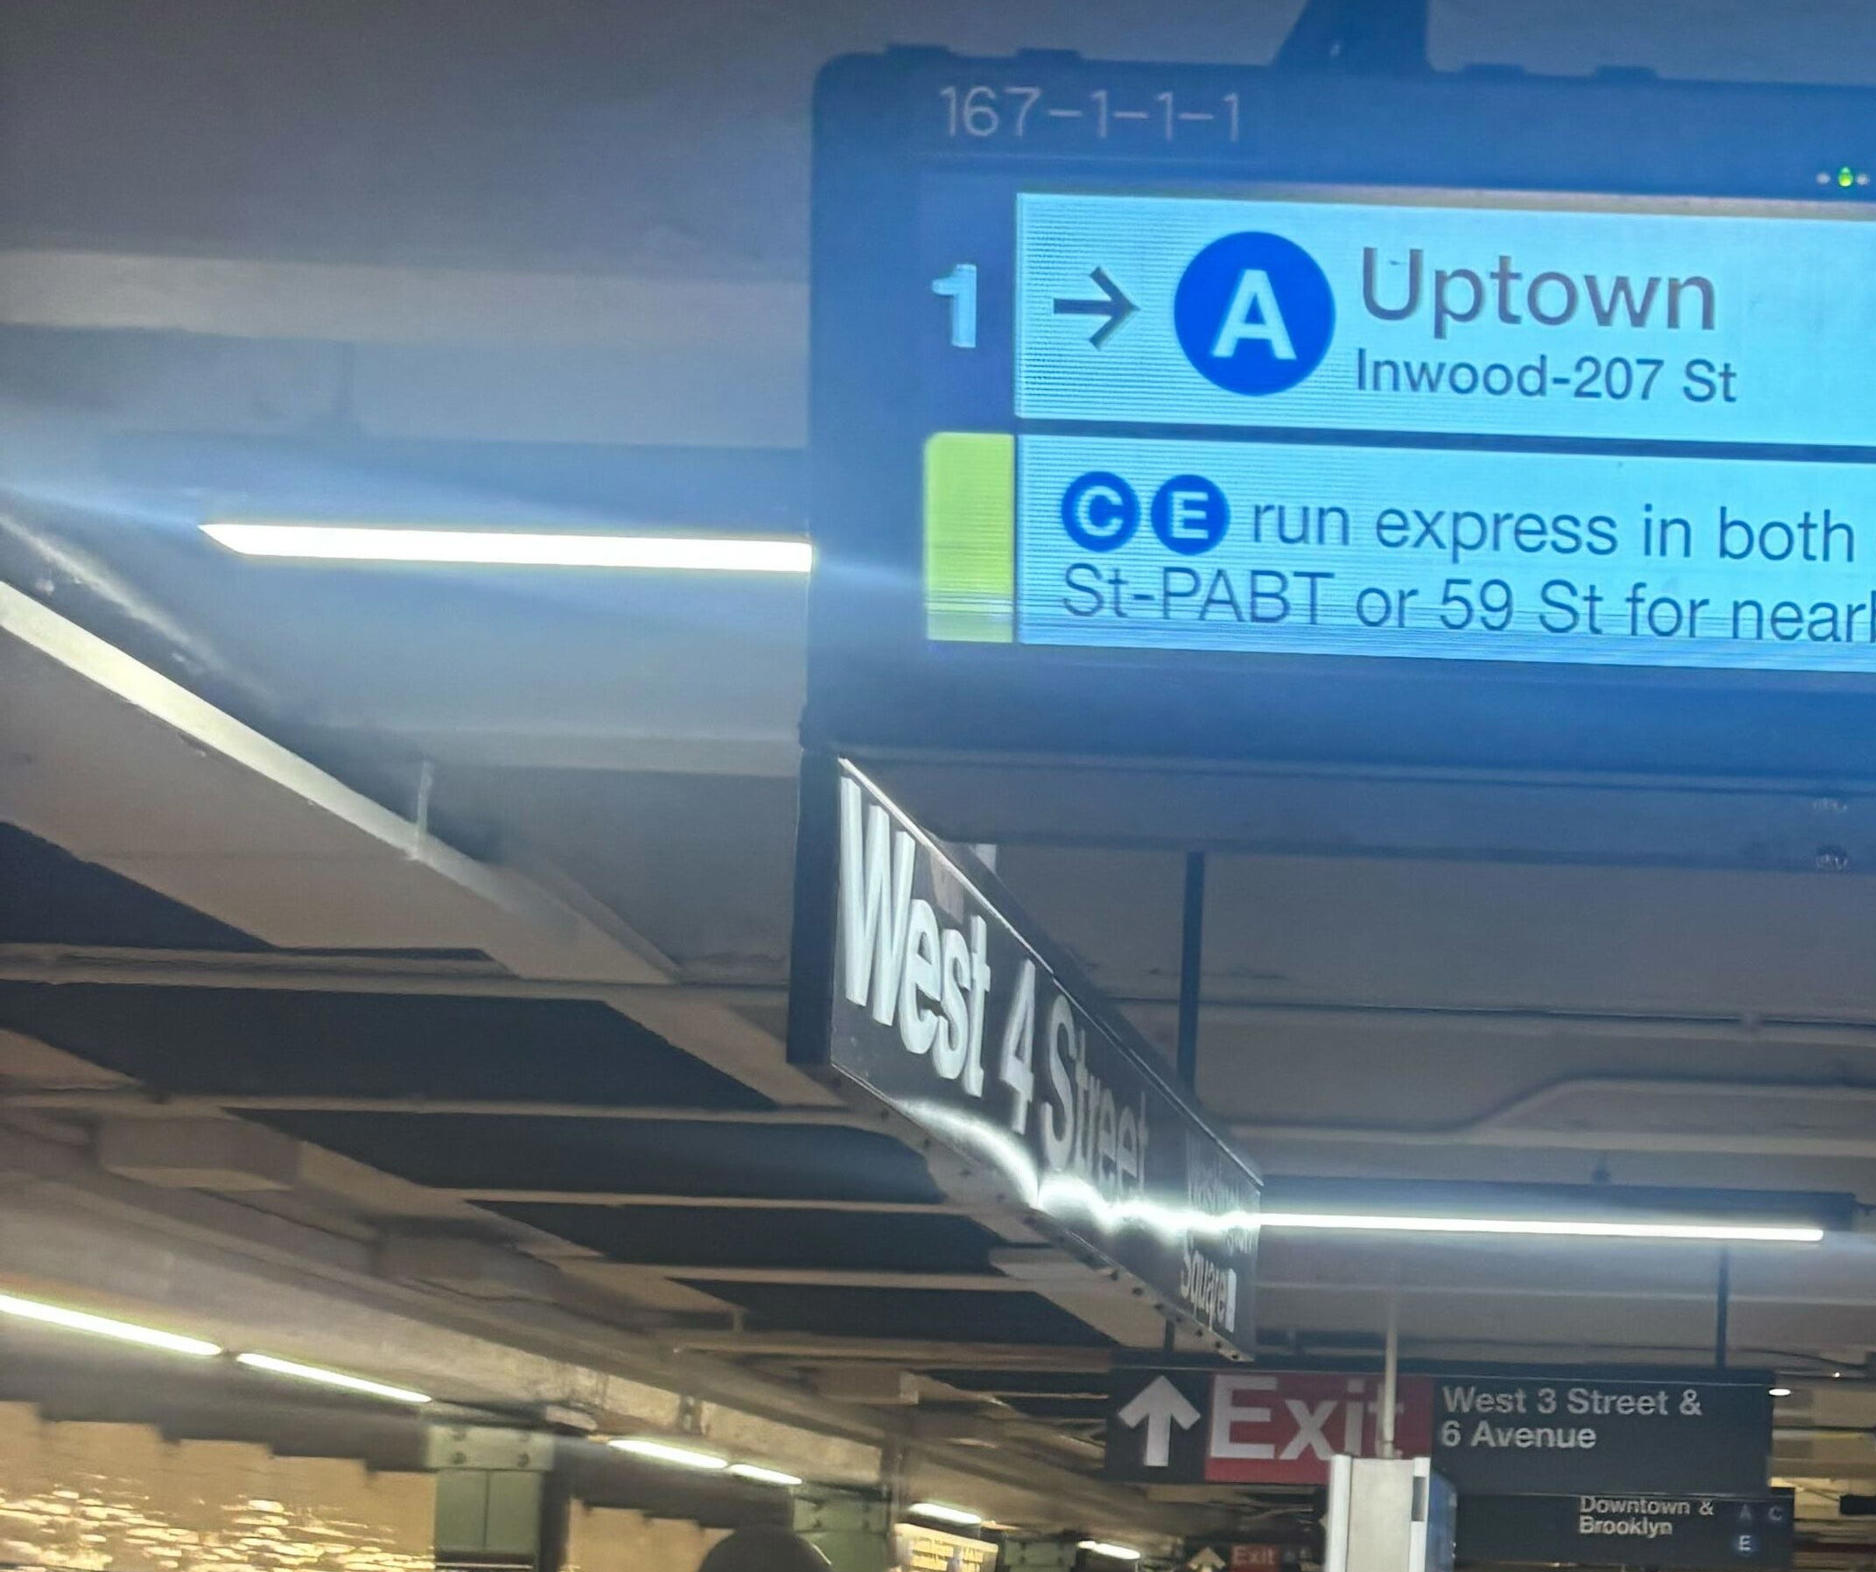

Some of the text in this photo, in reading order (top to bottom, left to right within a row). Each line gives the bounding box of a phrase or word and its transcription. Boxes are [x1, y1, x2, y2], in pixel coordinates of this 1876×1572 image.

[938, 83, 1244, 142] 167-1-1-1
[930, 262, 980, 350] 1
[1210, 267, 1299, 362] A
[1359, 245, 1719, 340] Uptown
[1355, 346, 1738, 404] Inwood-207 St
[1250, 504, 1351, 548] run
[1373, 507, 1618, 565] express
[1642, 502, 1694, 558] in
[1716, 503, 1856, 564] both
[1060, 559, 1335, 627] St-PABT
[1354, 582, 1420, 630] or
[1437, 579, 1515, 634] 59
[1537, 582, 1605, 637] St
[1624, 582, 1710, 641] for
[839, 774, 992, 1098] West
[1000, 957, 1037, 1137] 4
[1039, 992, 1150, 1207] Street
[1210, 1374, 1405, 1461] Exit
[1441, 1385, 1703, 1417] West 3 Street &
[1440, 1419, 1597, 1450] 6 Avenue
[1579, 1514, 1673, 1539] Brooklyn
[1580, 1496, 1715, 1516] Downtown &
